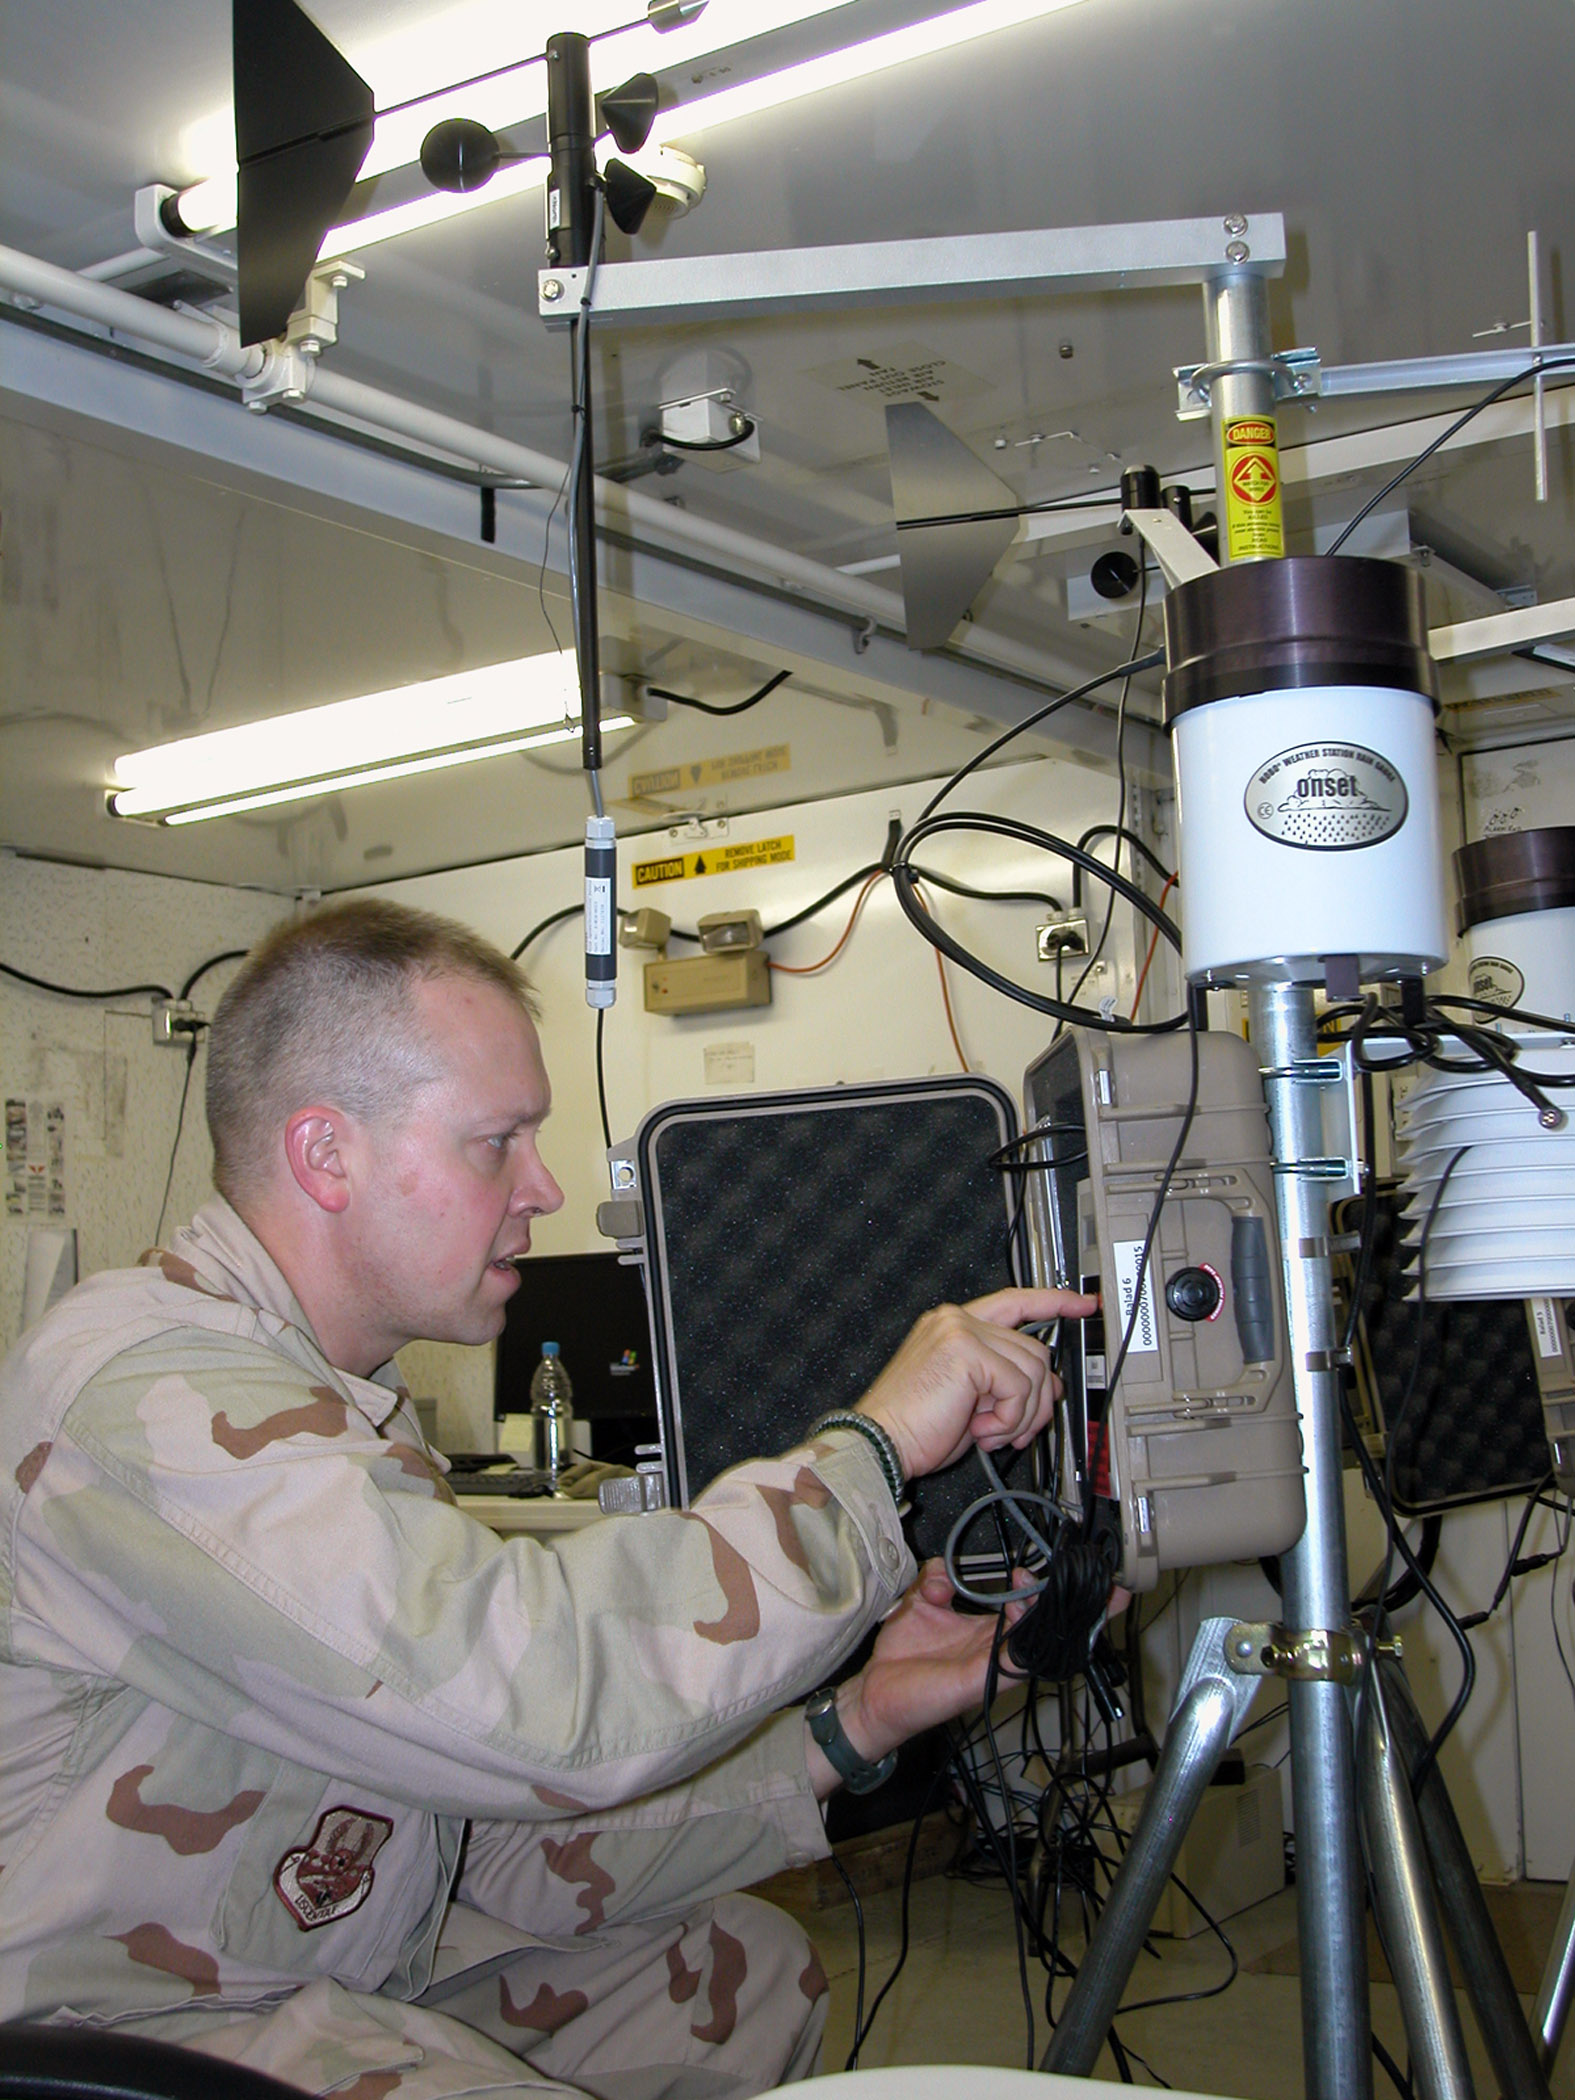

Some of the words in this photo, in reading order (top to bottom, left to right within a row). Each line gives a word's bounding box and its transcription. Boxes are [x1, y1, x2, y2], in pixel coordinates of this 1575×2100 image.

[1232, 426, 1271, 441] DANGER
[1282, 748, 1320, 767] WEATHER
[1321, 748, 1355, 759] STATION
[1356, 750, 1375, 766] RAIN
[1297, 775, 1358, 798] onset
[724, 844, 755, 858] REMOVE
[756, 839, 782, 853] LATCH
[715, 860, 730, 873] FOR
[732, 853, 768, 870] SHIPPING
[769, 849, 792, 863] MODE
[637, 859, 684, 883] CAUTION
[1122, 1277, 1132, 1285] 6
